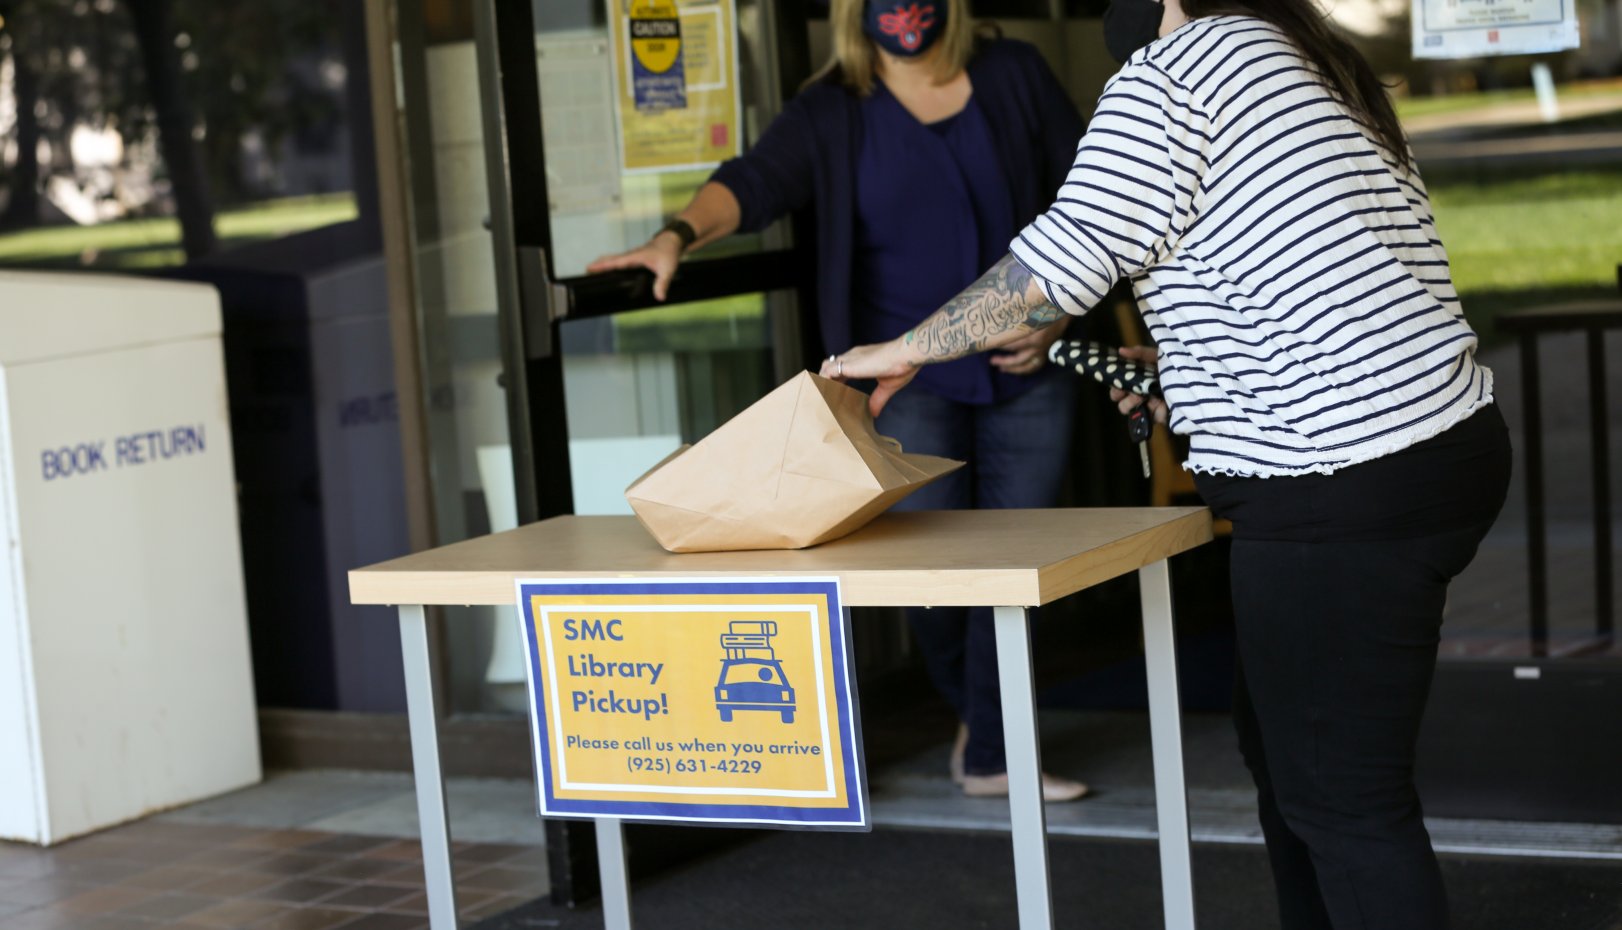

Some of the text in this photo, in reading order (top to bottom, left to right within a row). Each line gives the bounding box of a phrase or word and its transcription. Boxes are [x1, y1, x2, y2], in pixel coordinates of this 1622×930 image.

[634, 22, 676, 36] CAUTION
[41, 424, 206, 481] BOOK RETURN
[563, 618, 624, 641] SMC
[567, 654, 664, 685] Library
[571, 690, 669, 720] Pickup!
[566, 735, 821, 758] Please call us when you arrive
[627, 757, 762, 774] (925) 631-4229
